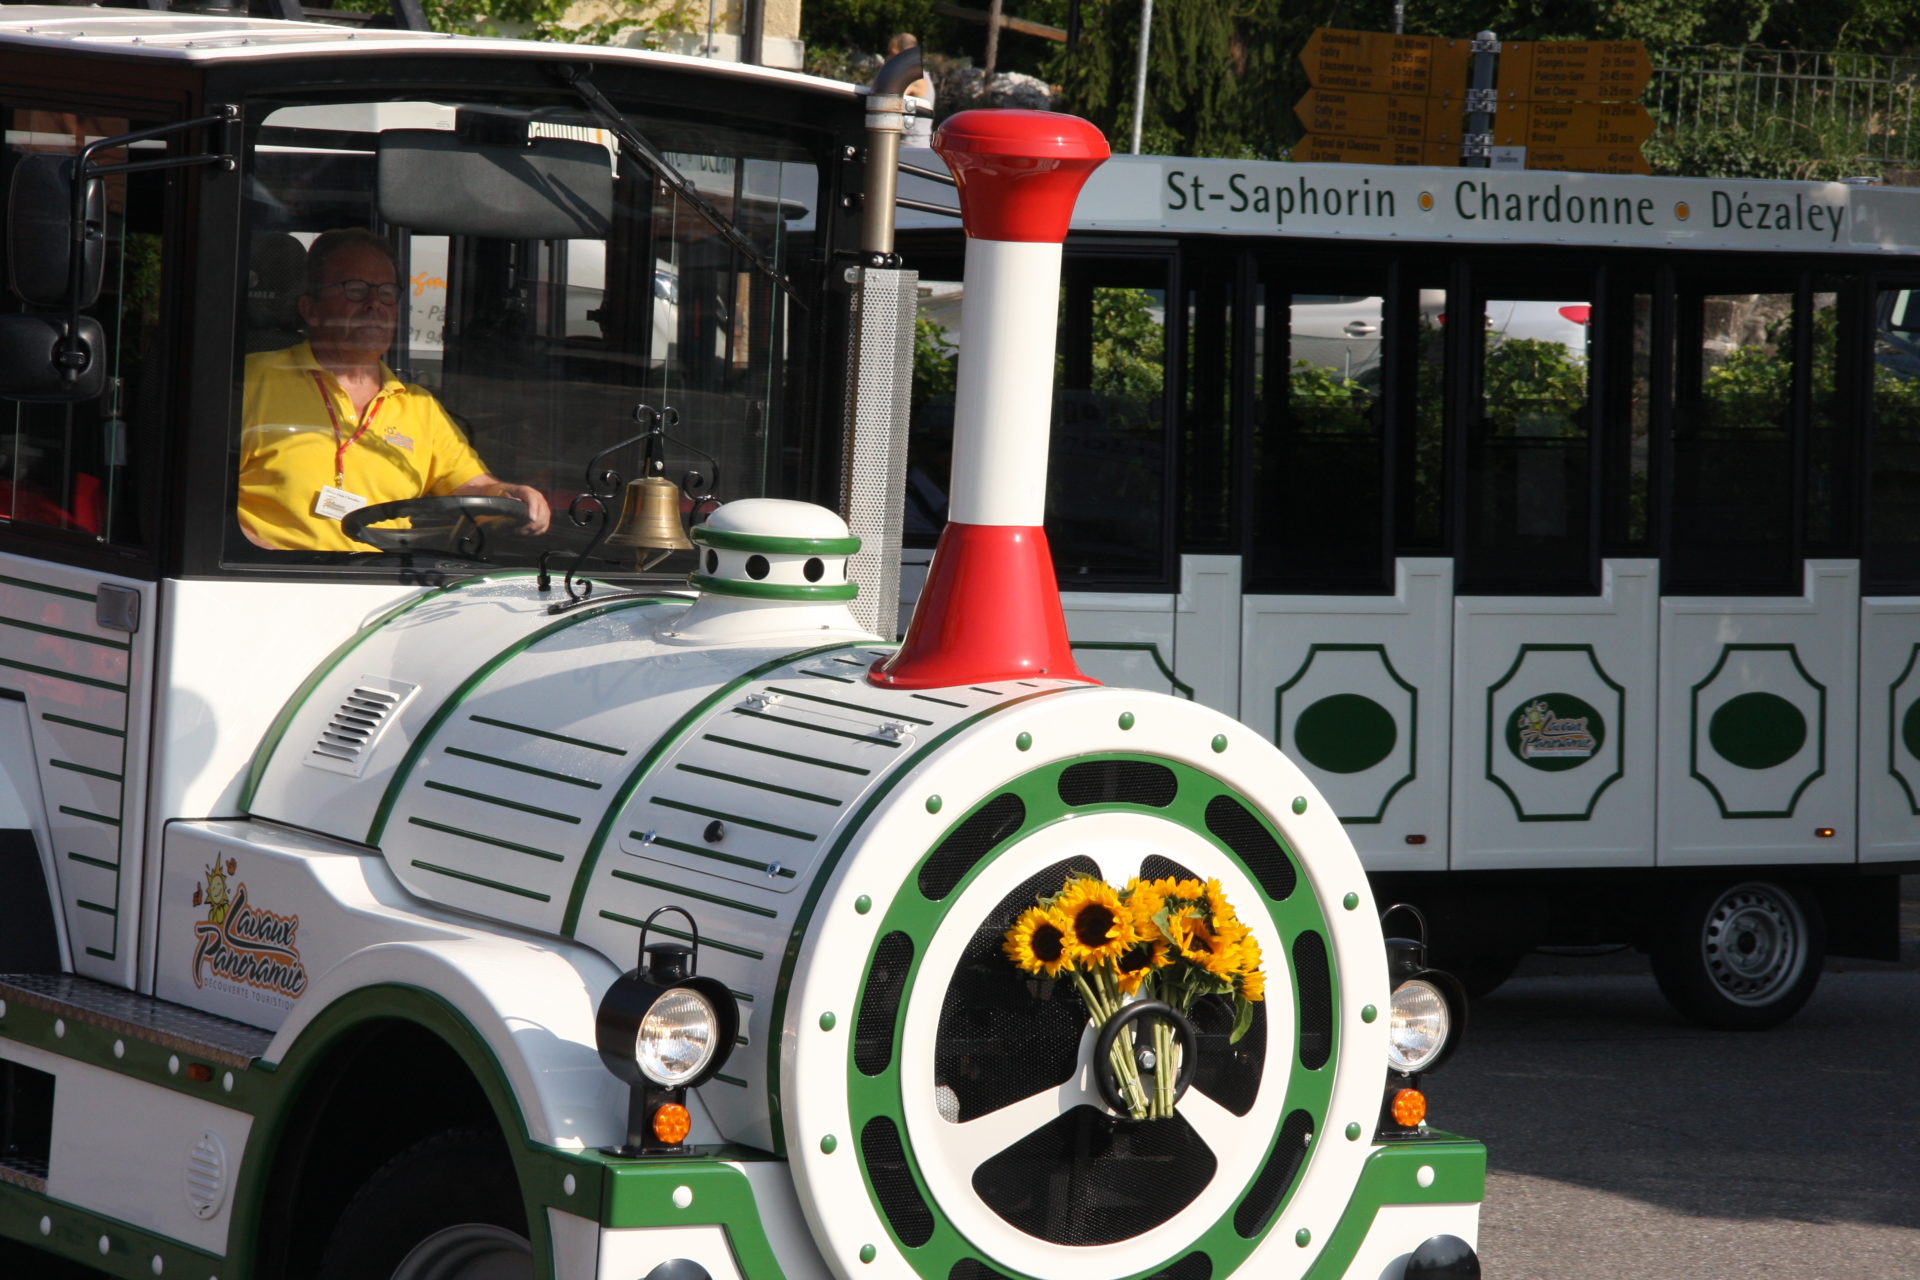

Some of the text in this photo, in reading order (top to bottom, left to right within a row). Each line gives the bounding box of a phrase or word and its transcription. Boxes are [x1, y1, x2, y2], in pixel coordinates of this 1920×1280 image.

[1167, 170, 1396, 225] St-Saphorin
[1455, 180, 1655, 226] Chardonne
[1711, 190, 1845, 242] Dézaley
[223, 887, 298, 957] Lavaux
[194, 924, 306, 994] Panoramic
